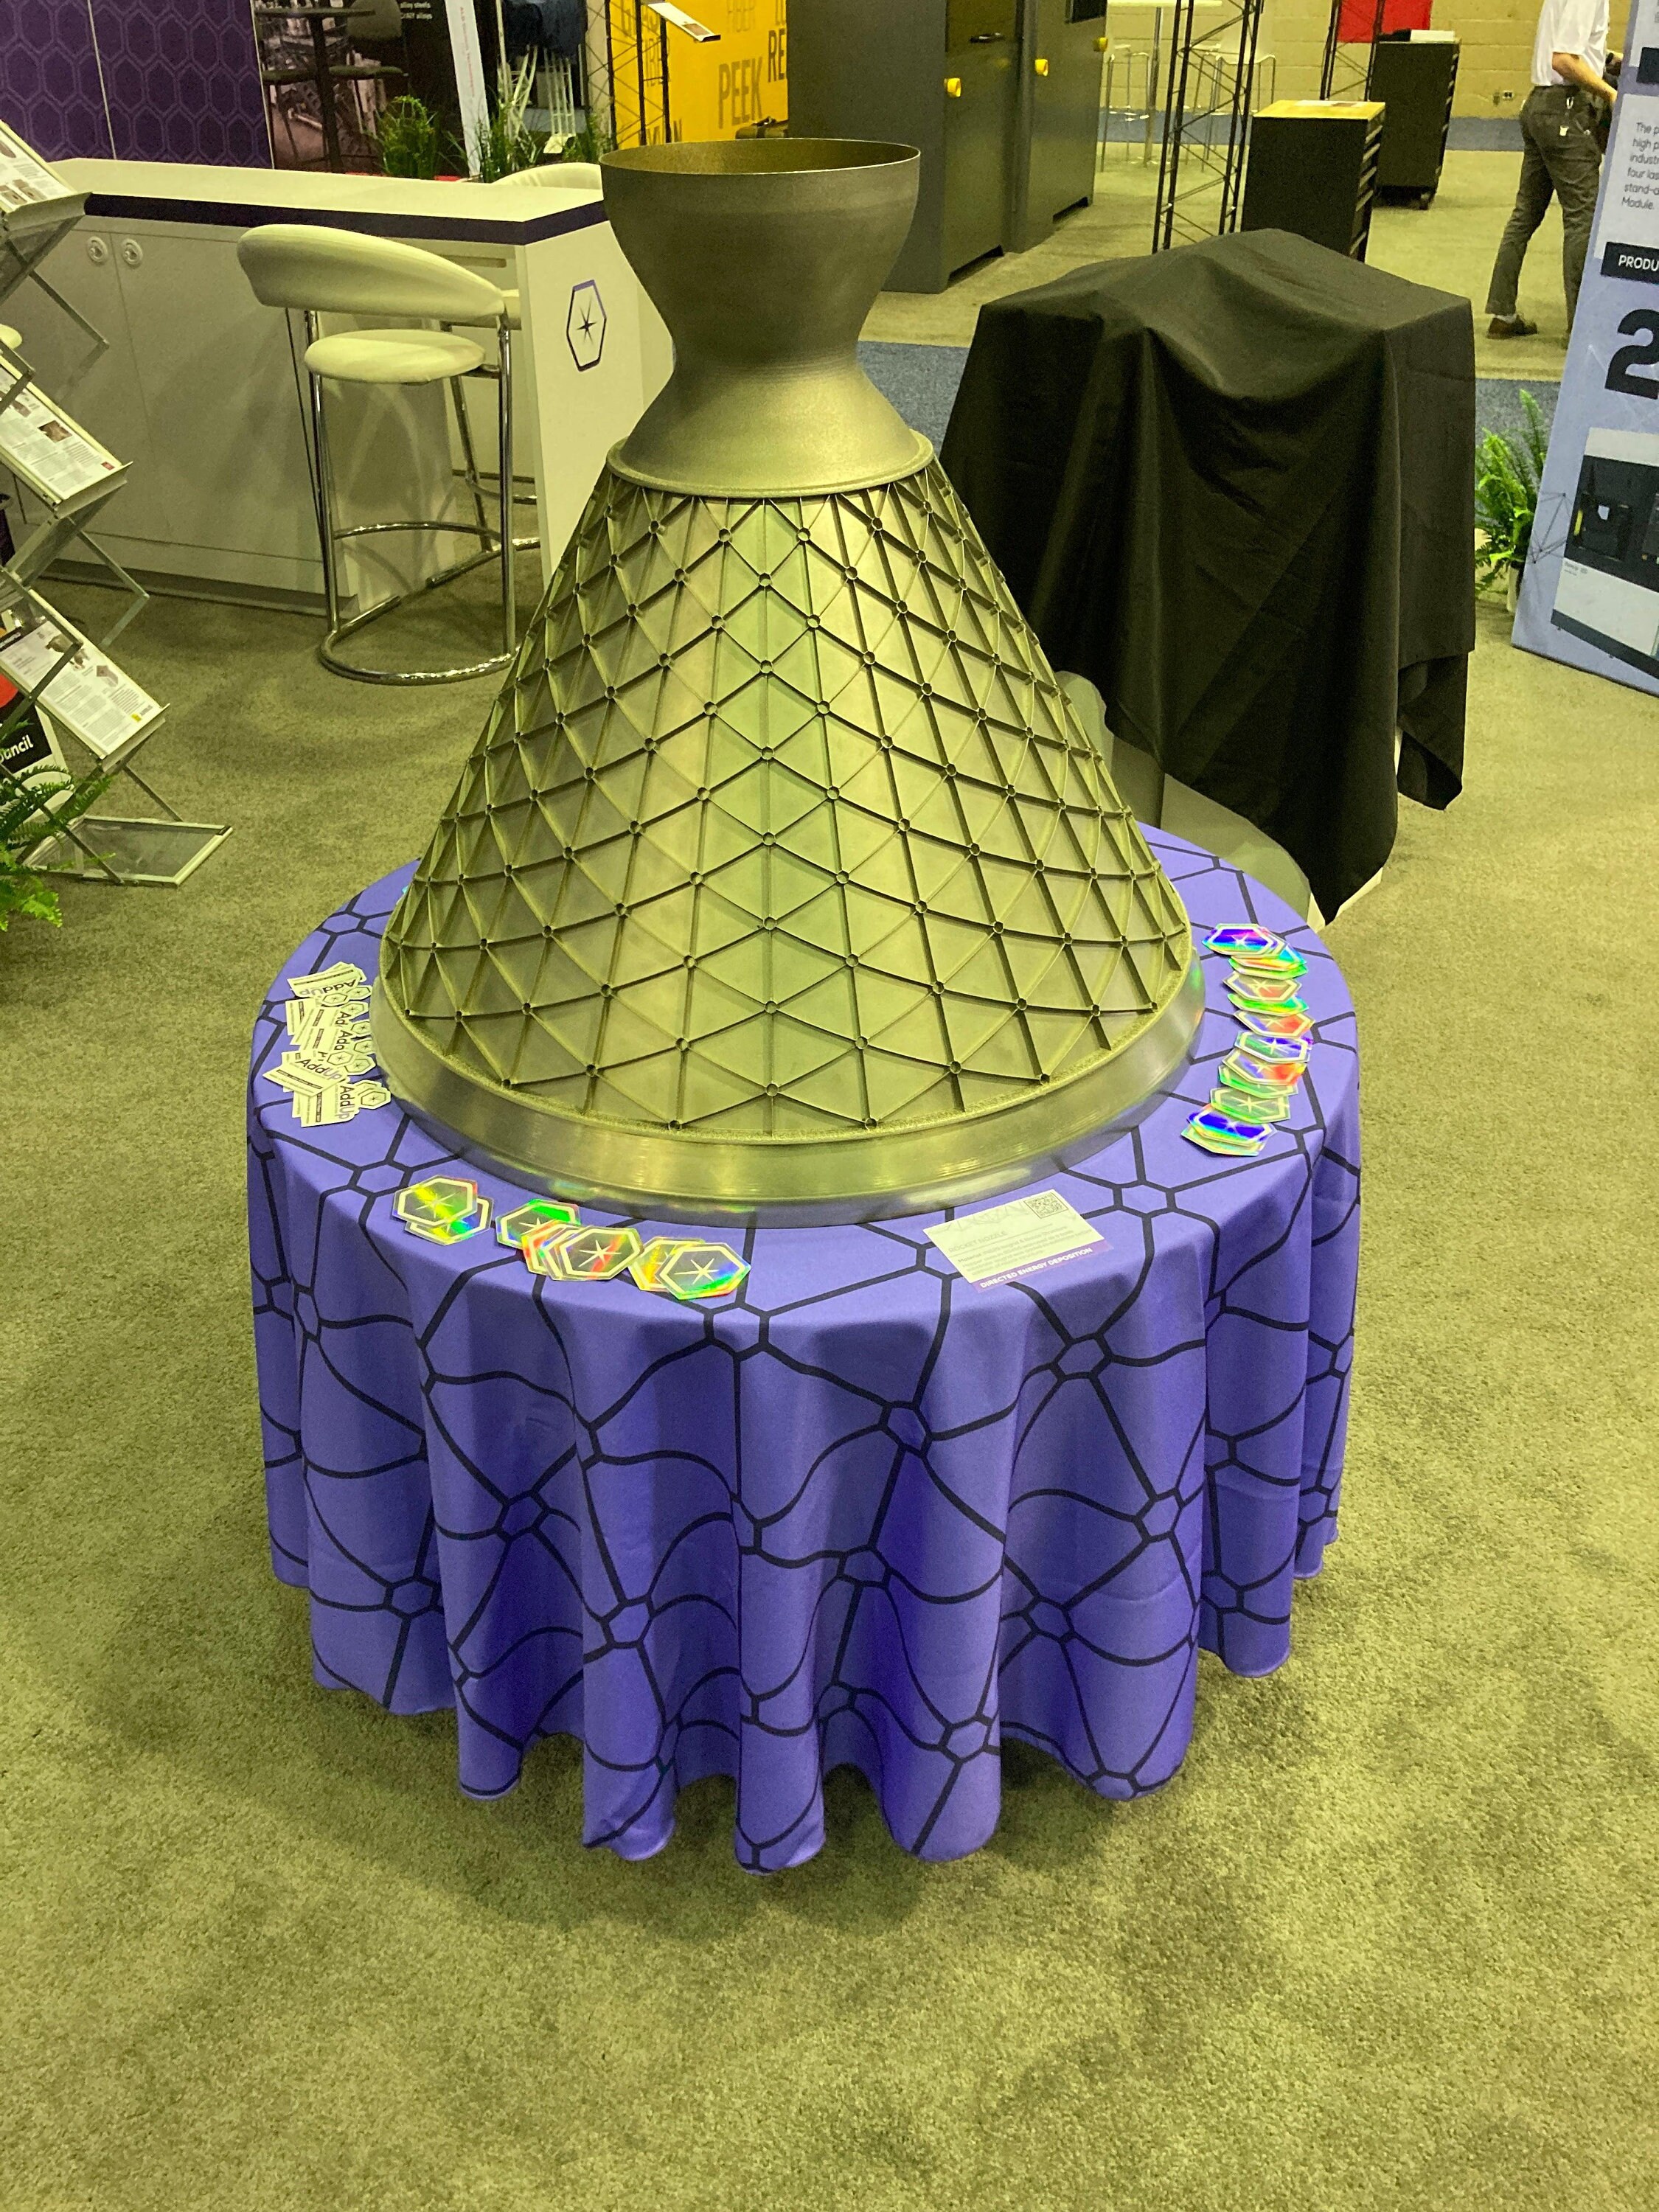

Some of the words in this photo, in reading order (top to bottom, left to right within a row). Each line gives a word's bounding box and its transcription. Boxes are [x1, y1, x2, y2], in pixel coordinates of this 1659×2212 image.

[718, 57, 762, 129] PEEK
[1636, 122, 1652, 133] The
[1632, 138, 1652, 152] high
[1627, 167, 1646, 178] four
[1618, 254, 1659, 271] PRODU
[1604, 308, 1659, 400] 2
[299, 979, 356, 995] AddUp
[295, 1059, 342, 1080] AddUp
[335, 1085, 355, 1119] AddUp
[949, 1238, 978, 1253] ROCKET
[978, 1231, 1008, 1245] NOZZLE
[979, 1271, 1018, 1288] DIRECTED
[1018, 1262, 1048, 1276] ENERGY
[1048, 1248, 1093, 1266] DEPOSITION
